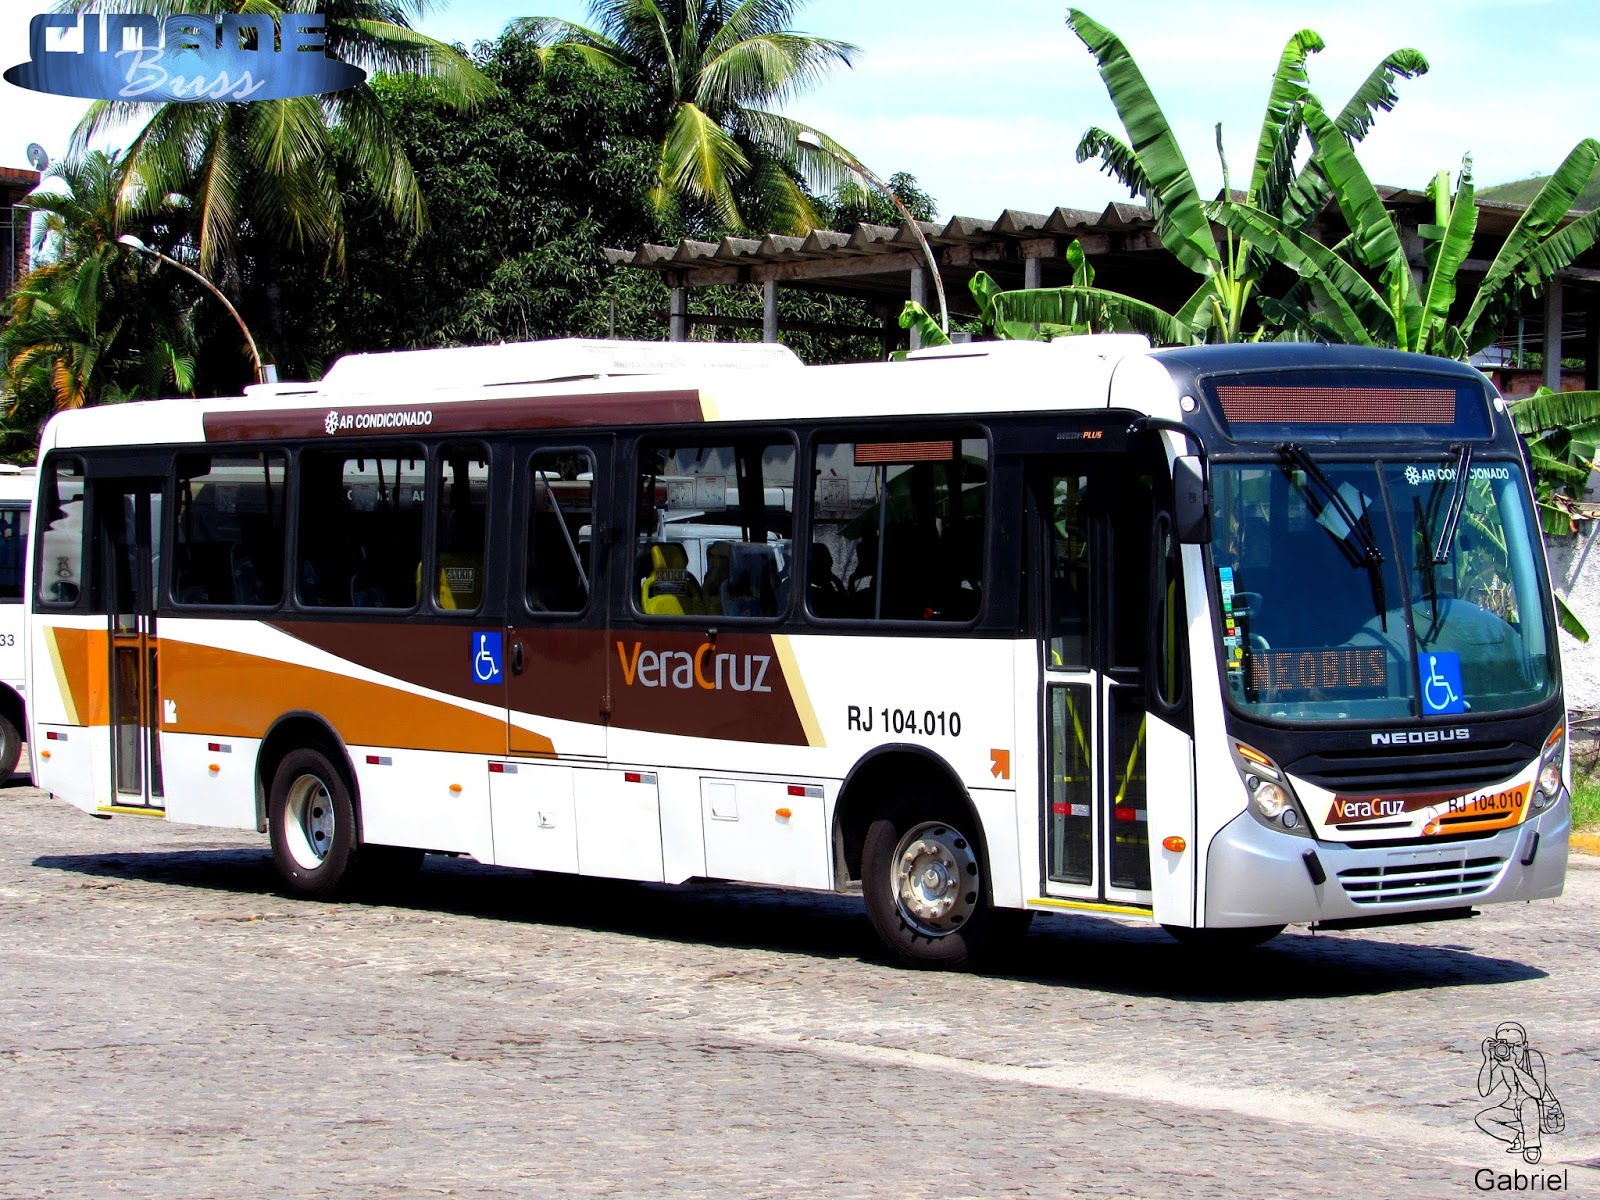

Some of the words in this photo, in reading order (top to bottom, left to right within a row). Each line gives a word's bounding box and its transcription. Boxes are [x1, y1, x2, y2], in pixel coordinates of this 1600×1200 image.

[339, 415, 354, 429] AR
[355, 410, 433, 429] CONDICIONADO
[1421, 469, 1437, 481] AR
[616, 641, 772, 693] VeraCruz
[1251, 649, 1384, 691] NEOBUS
[847, 705, 873, 732] RJ
[880, 708, 962, 737] 104.010
[1371, 728, 1470, 745] NEOBUS
[1333, 798, 1406, 818] VeraCruz
[1448, 798, 1467, 814] RJ
[1471, 791, 1523, 812] 104.010
